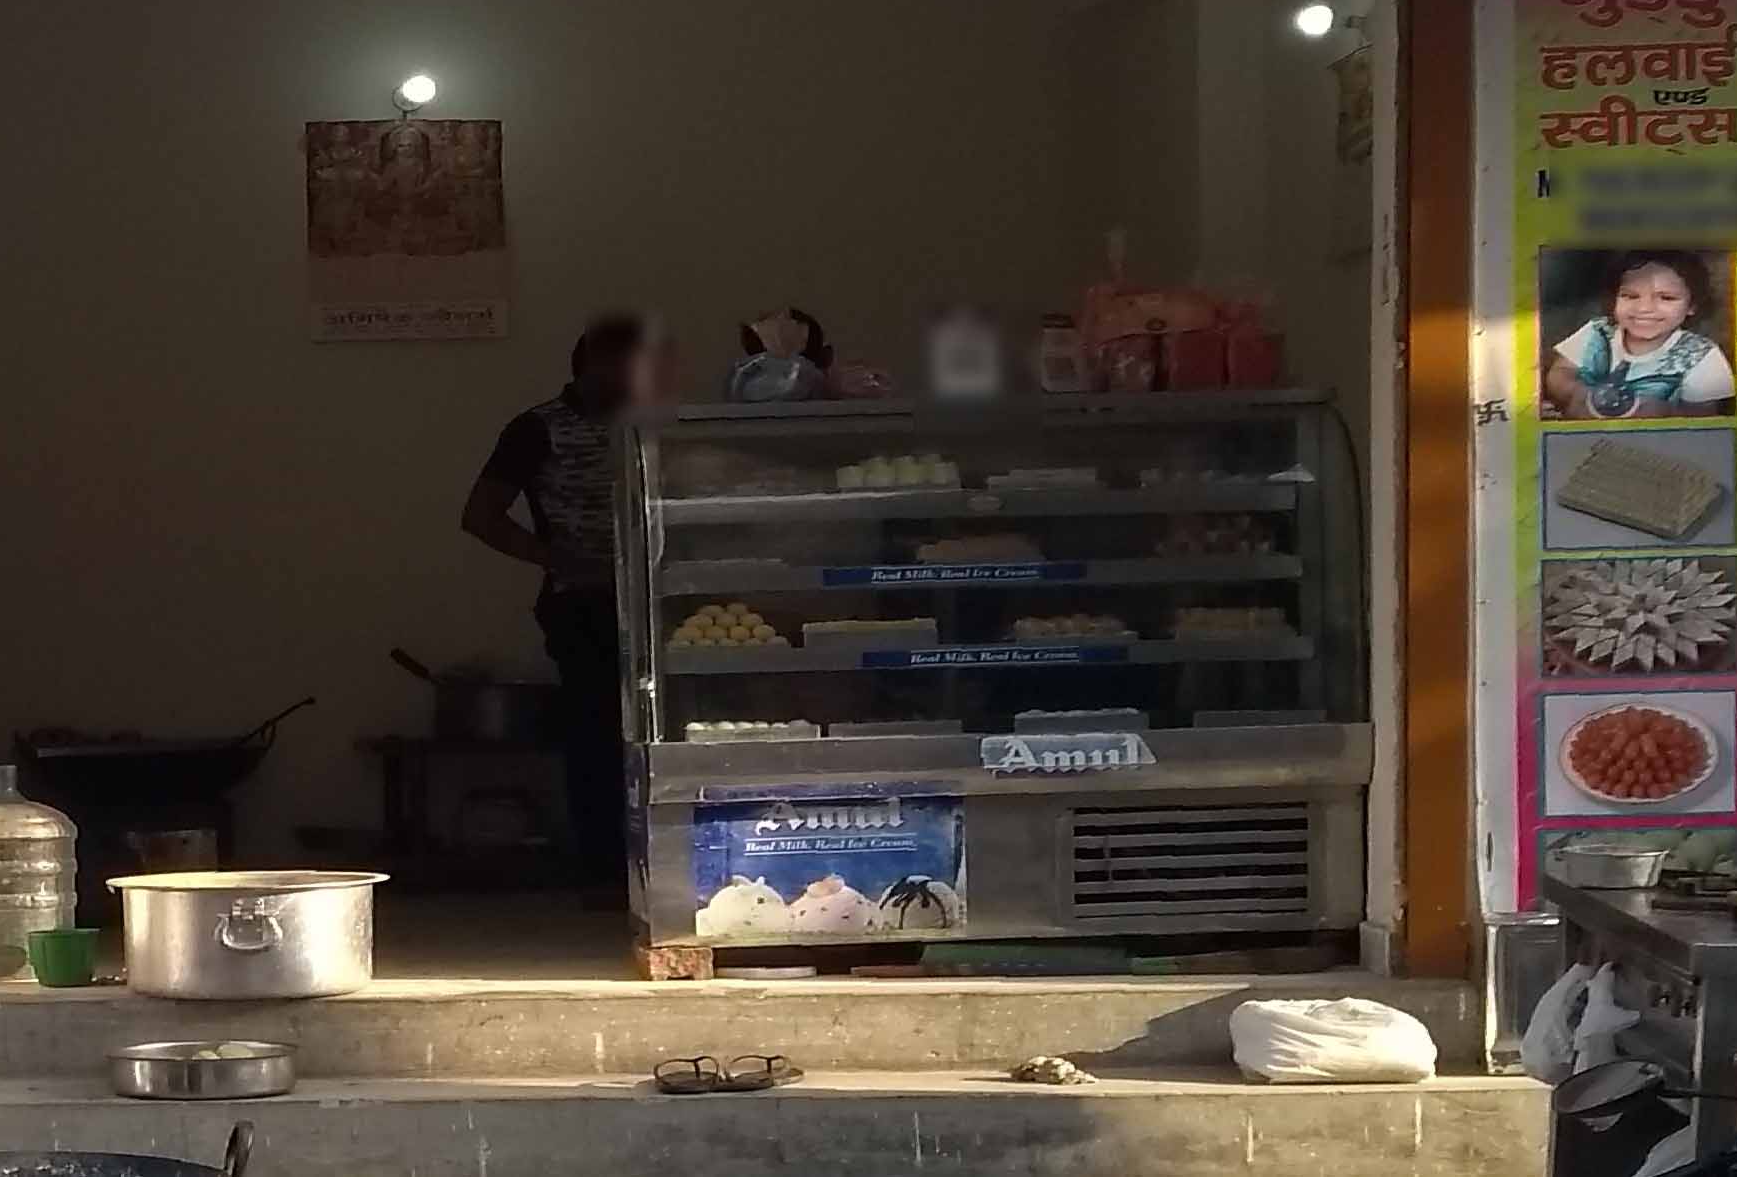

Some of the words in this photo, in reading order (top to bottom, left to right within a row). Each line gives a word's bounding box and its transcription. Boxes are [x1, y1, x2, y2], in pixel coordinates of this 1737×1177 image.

[1539, 23, 1737, 90] हलवाई
[1652, 87, 1711, 106] एण्ड
[871, 570, 901, 582] Real
[940, 568, 970, 579] Real
[911, 654, 941, 664] Real
[980, 651, 1010, 662] Real
[999, 733, 1142, 772] Amul
[755, 796, 904, 836] Amul
[744, 842, 776, 853] Real
[815, 839, 846, 851] Real
[848, 838, 867, 849] Ice
